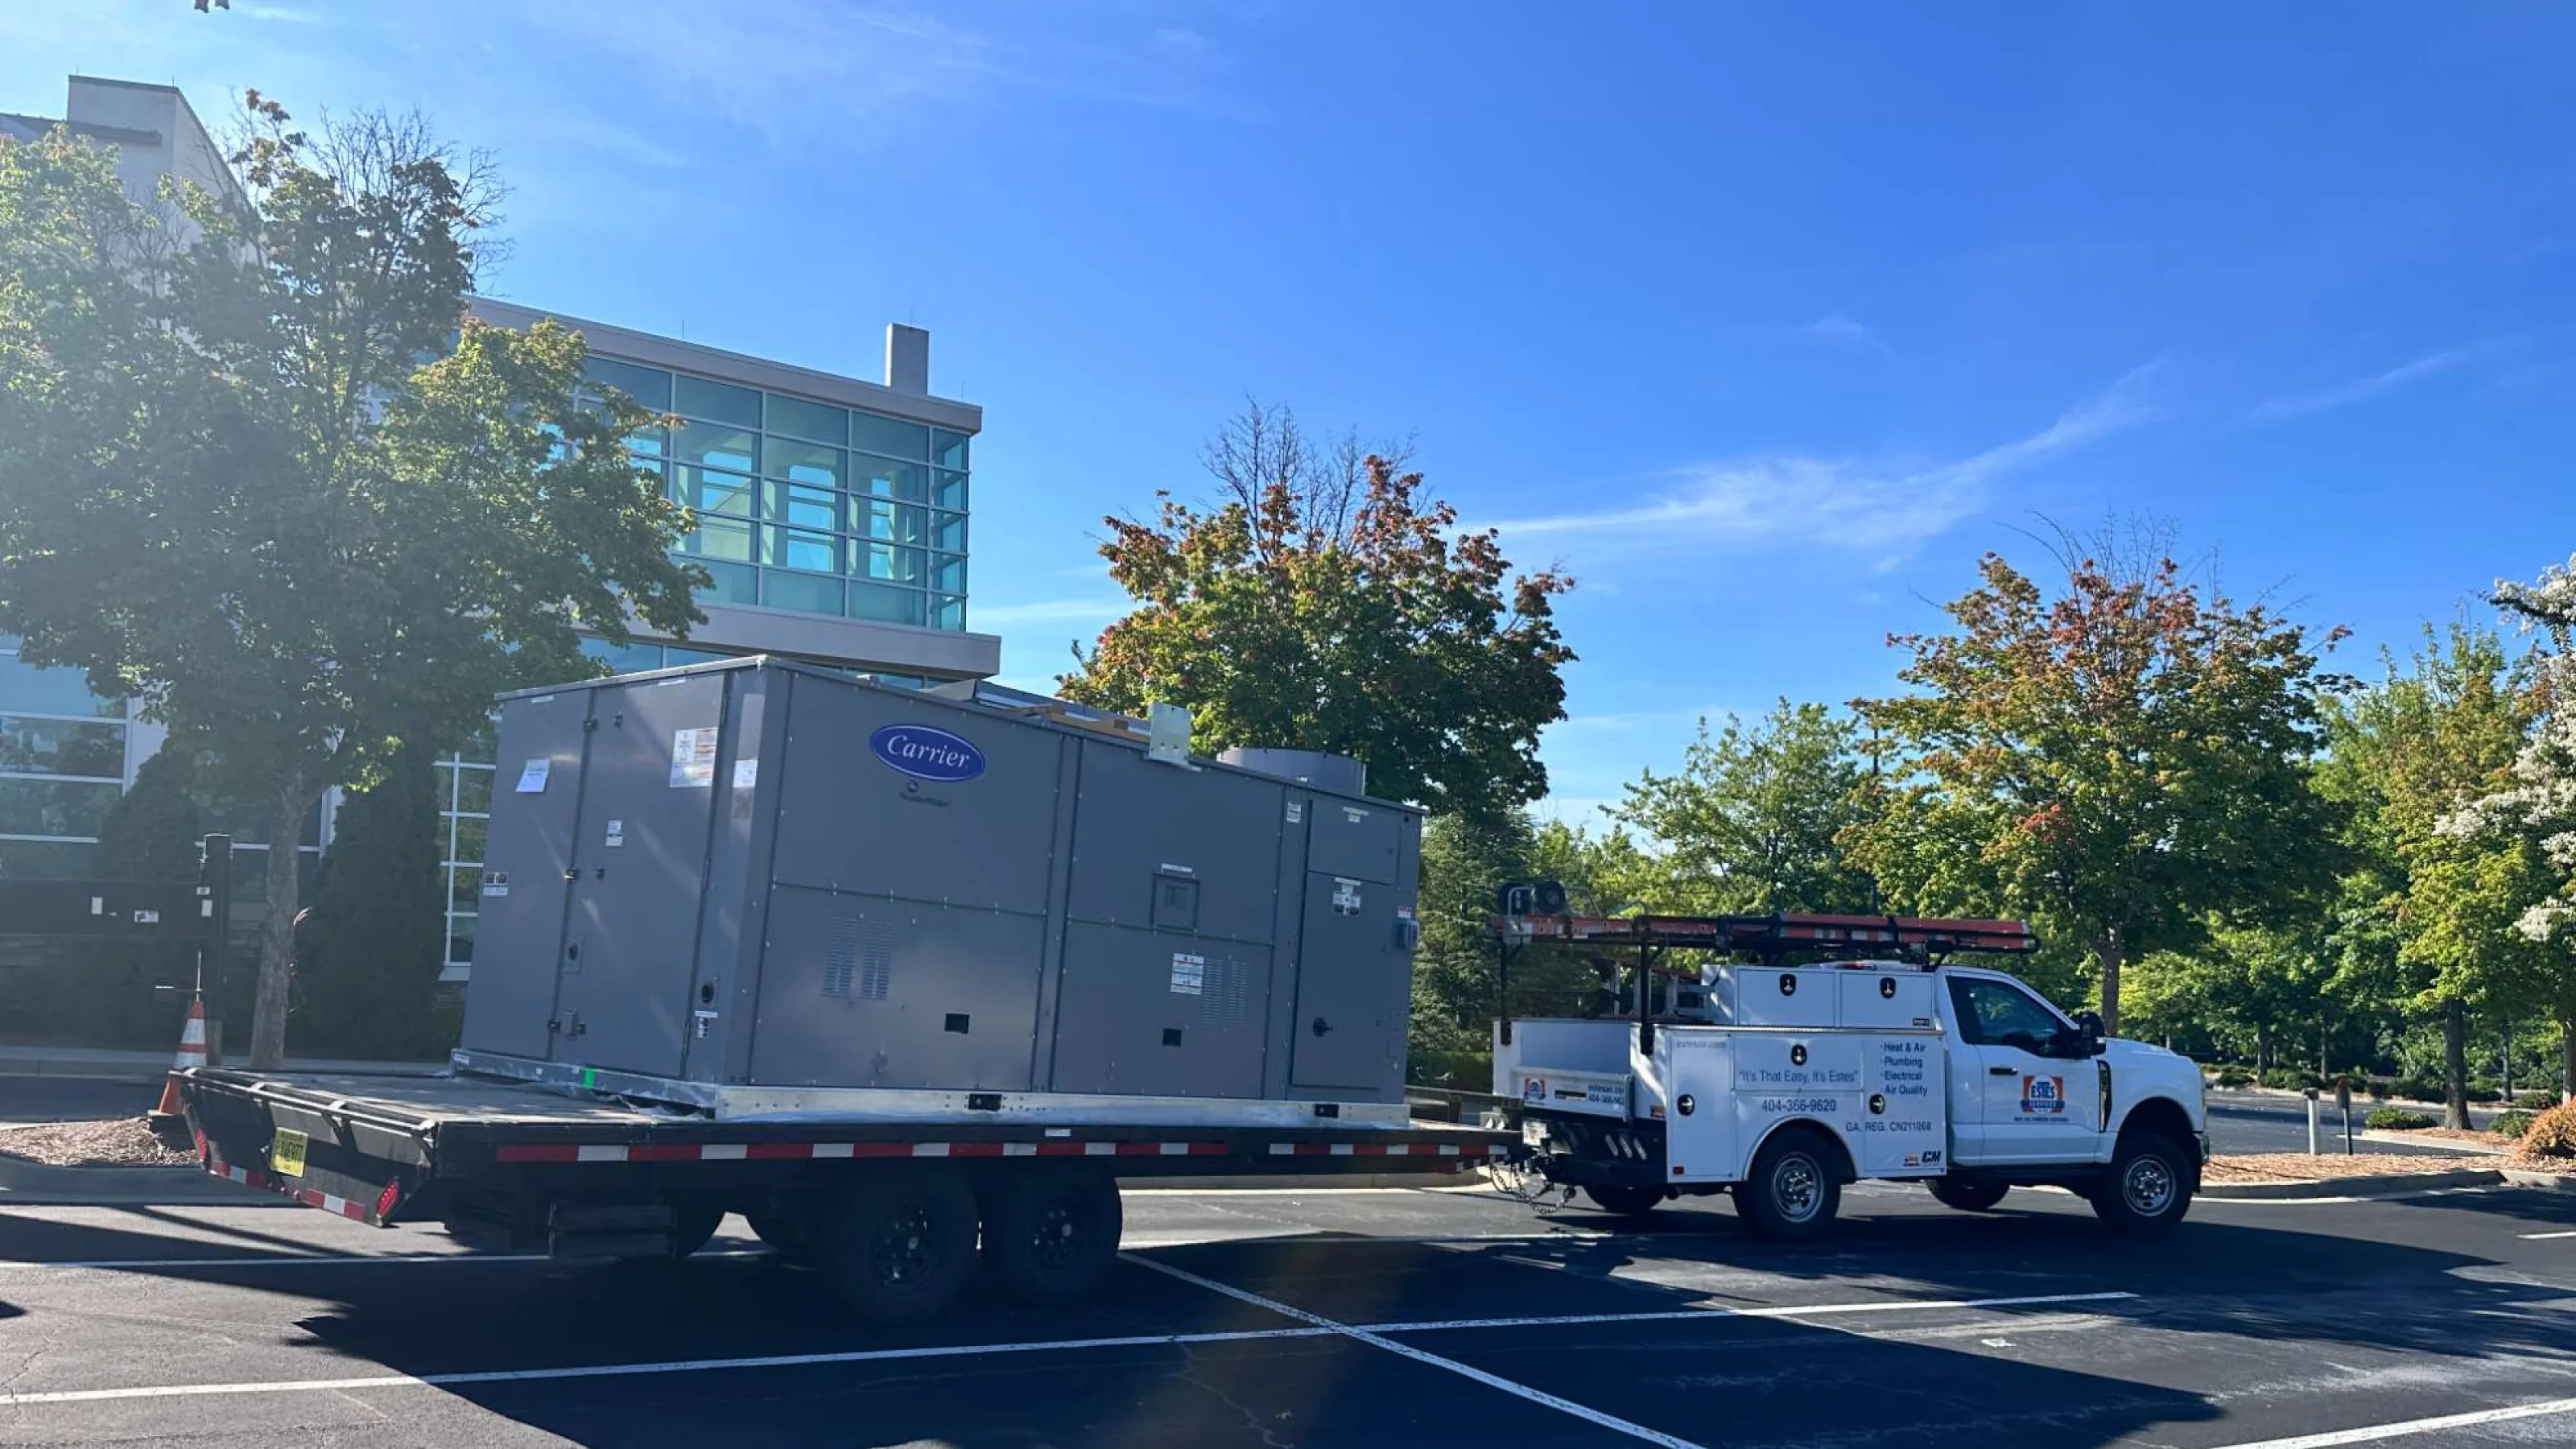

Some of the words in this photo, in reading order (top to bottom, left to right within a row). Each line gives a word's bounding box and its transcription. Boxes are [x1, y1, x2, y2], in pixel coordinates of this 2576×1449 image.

[887, 735, 969, 767] Carrier
[1885, 1042, 1903, 1052] Heat
[1905, 1042, 1911, 1052] &
[1913, 1042, 1926, 1053] Air
[1885, 1055, 1923, 1069] Plumbing
[1760, 1070, 1780, 1083] That
[1813, 1070, 1826, 1083] It's
[1885, 1070, 1922, 1080] Electrical
[1885, 1084, 1897, 1095] Air
[1899, 1084, 1928, 1096] Quality
[2031, 1084, 2055, 1099] ESTES
[1922, 1150, 1942, 1163] CM
